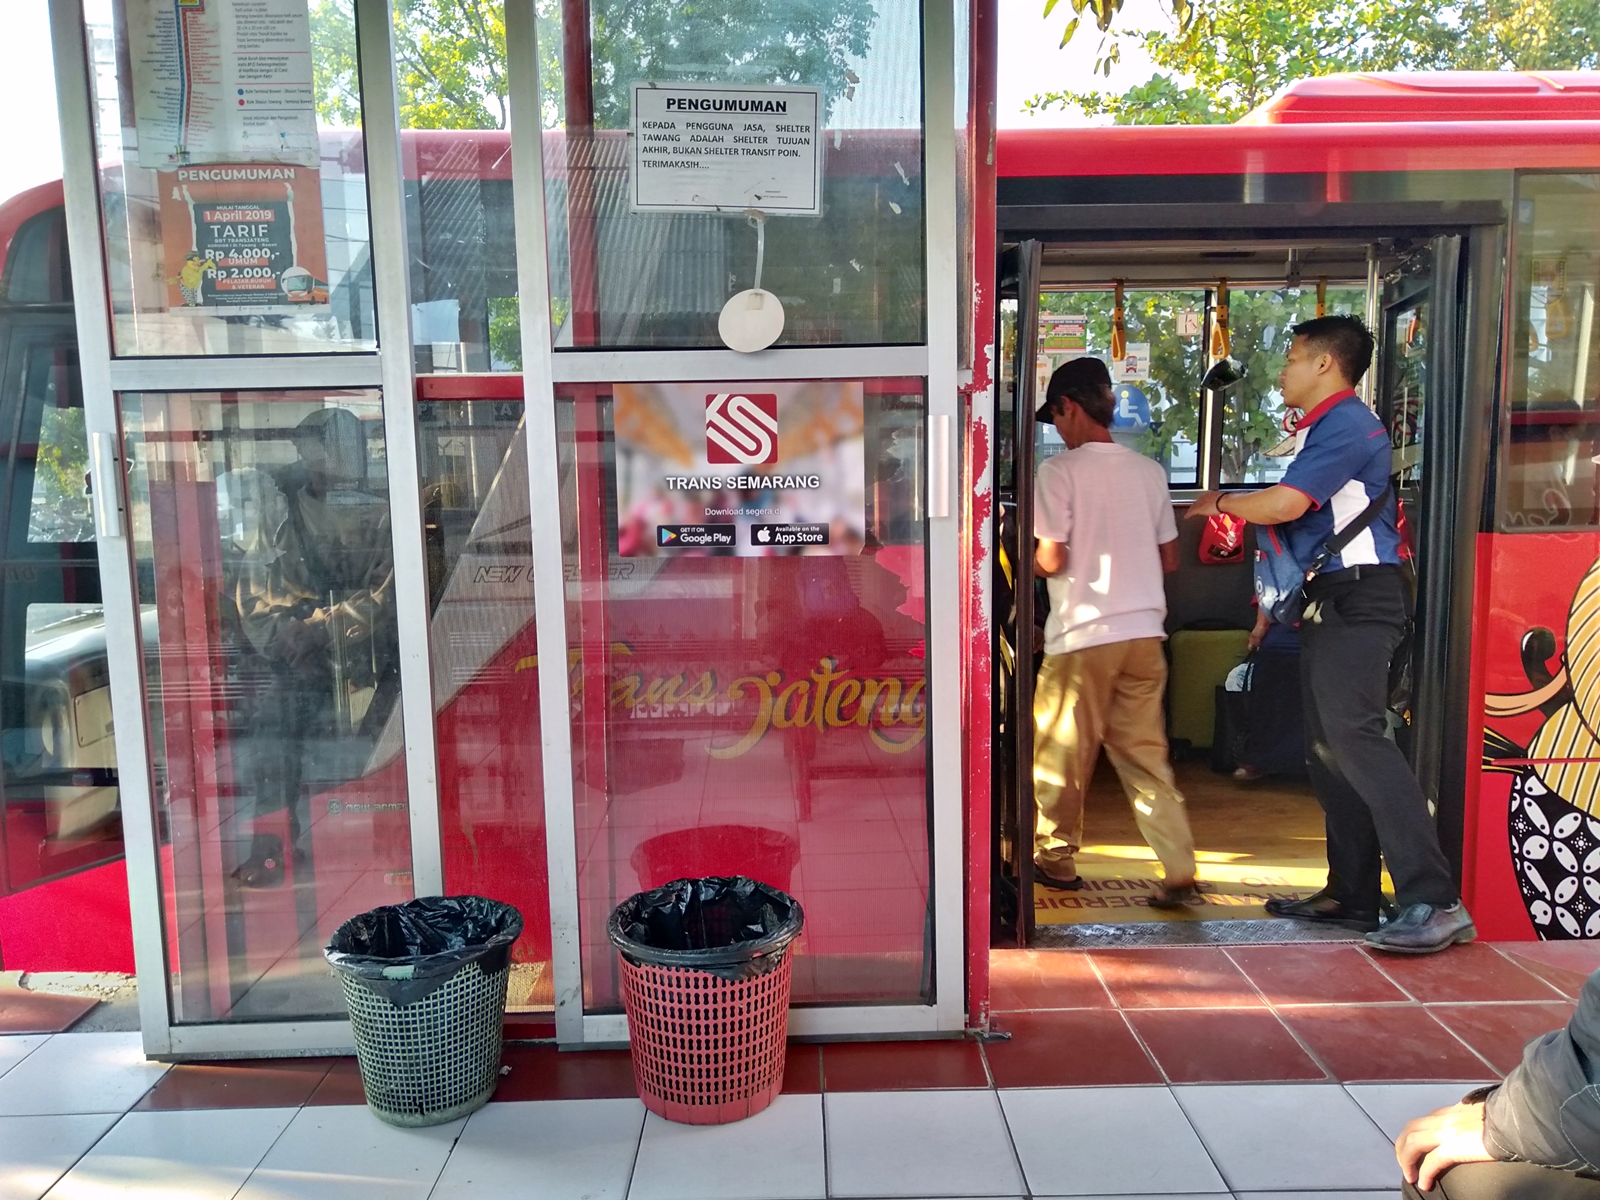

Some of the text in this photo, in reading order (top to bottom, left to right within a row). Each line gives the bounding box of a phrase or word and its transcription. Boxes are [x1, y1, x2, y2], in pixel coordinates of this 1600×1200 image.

[666, 98, 787, 113] PENGUMUMAN
[642, 121, 811, 133] KEPADA PENGGUNA JASA, SHELTER
[642, 134, 810, 145] TAWANG ADALAH SHELTER TUJUAN
[642, 146, 801, 158] AKHIR, BUKAN SHELTER TRANSIT POIN.
[178, 168, 296, 182] PENGUMUMAN
[205, 210, 272, 222] 1 April 2019
[210, 224, 268, 238] TARIF
[205, 248, 280, 261] Rp 4.000,-
[207, 267, 281, 281] Rp 2.000,-
[666, 475, 820, 490] TRANS SEMARANG
[704, 507, 744, 516] Download
[745, 508, 773, 517] segera
[680, 533, 732, 544] Google Play
[474, 565, 525, 583] NEW
